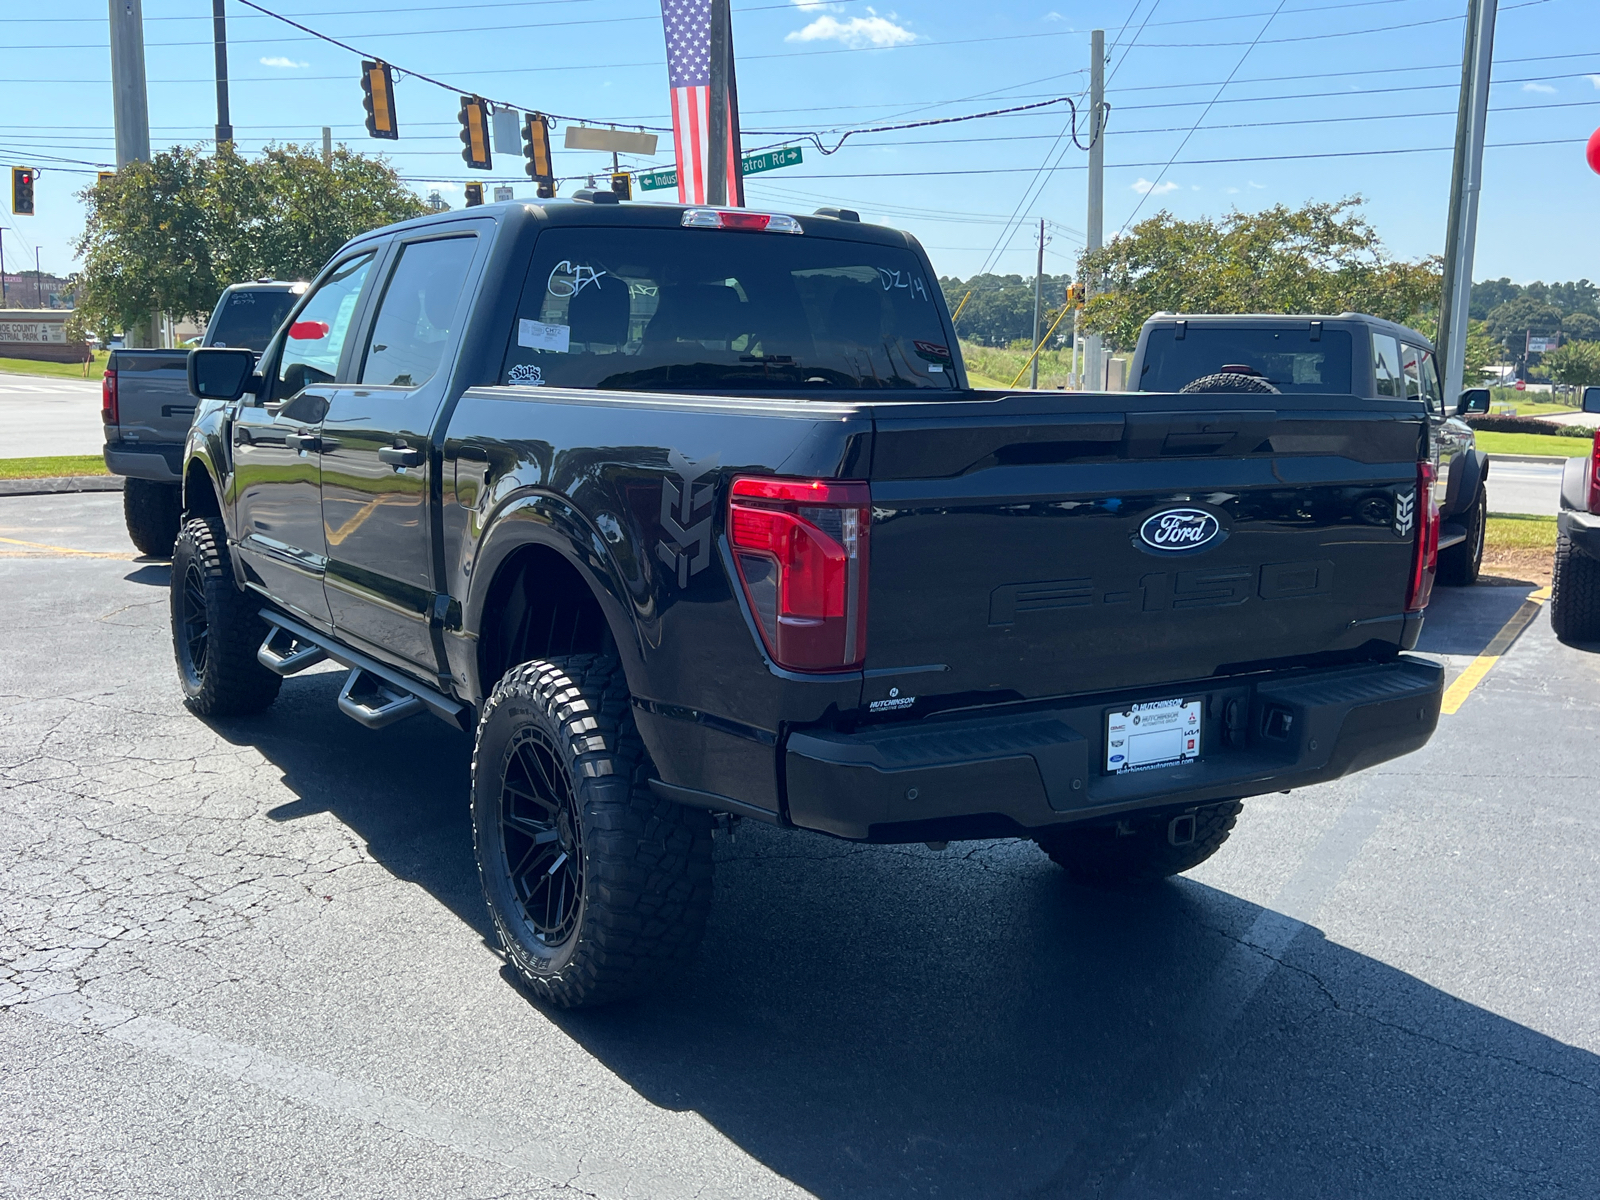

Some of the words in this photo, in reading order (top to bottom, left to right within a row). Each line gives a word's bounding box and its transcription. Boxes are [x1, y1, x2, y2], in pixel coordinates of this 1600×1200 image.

[742, 156, 766, 172] atrol
[771, 152, 786, 166] Rd
[0, 323, 11, 333] OE
[12, 324, 39, 333] COUNTY
[22, 332, 39, 342] PARK
[1154, 514, 1207, 544] Ford
[987, 559, 1335, 628] F-150
[869, 697, 916, 709] HUTCHINSON
[1139, 698, 1183, 711] HUTCHINSON
[869, 705, 897, 713] AUTOMOTIVE
[1142, 712, 1179, 722] HUTCHINSON
[1184, 728, 1200, 737] KIA
